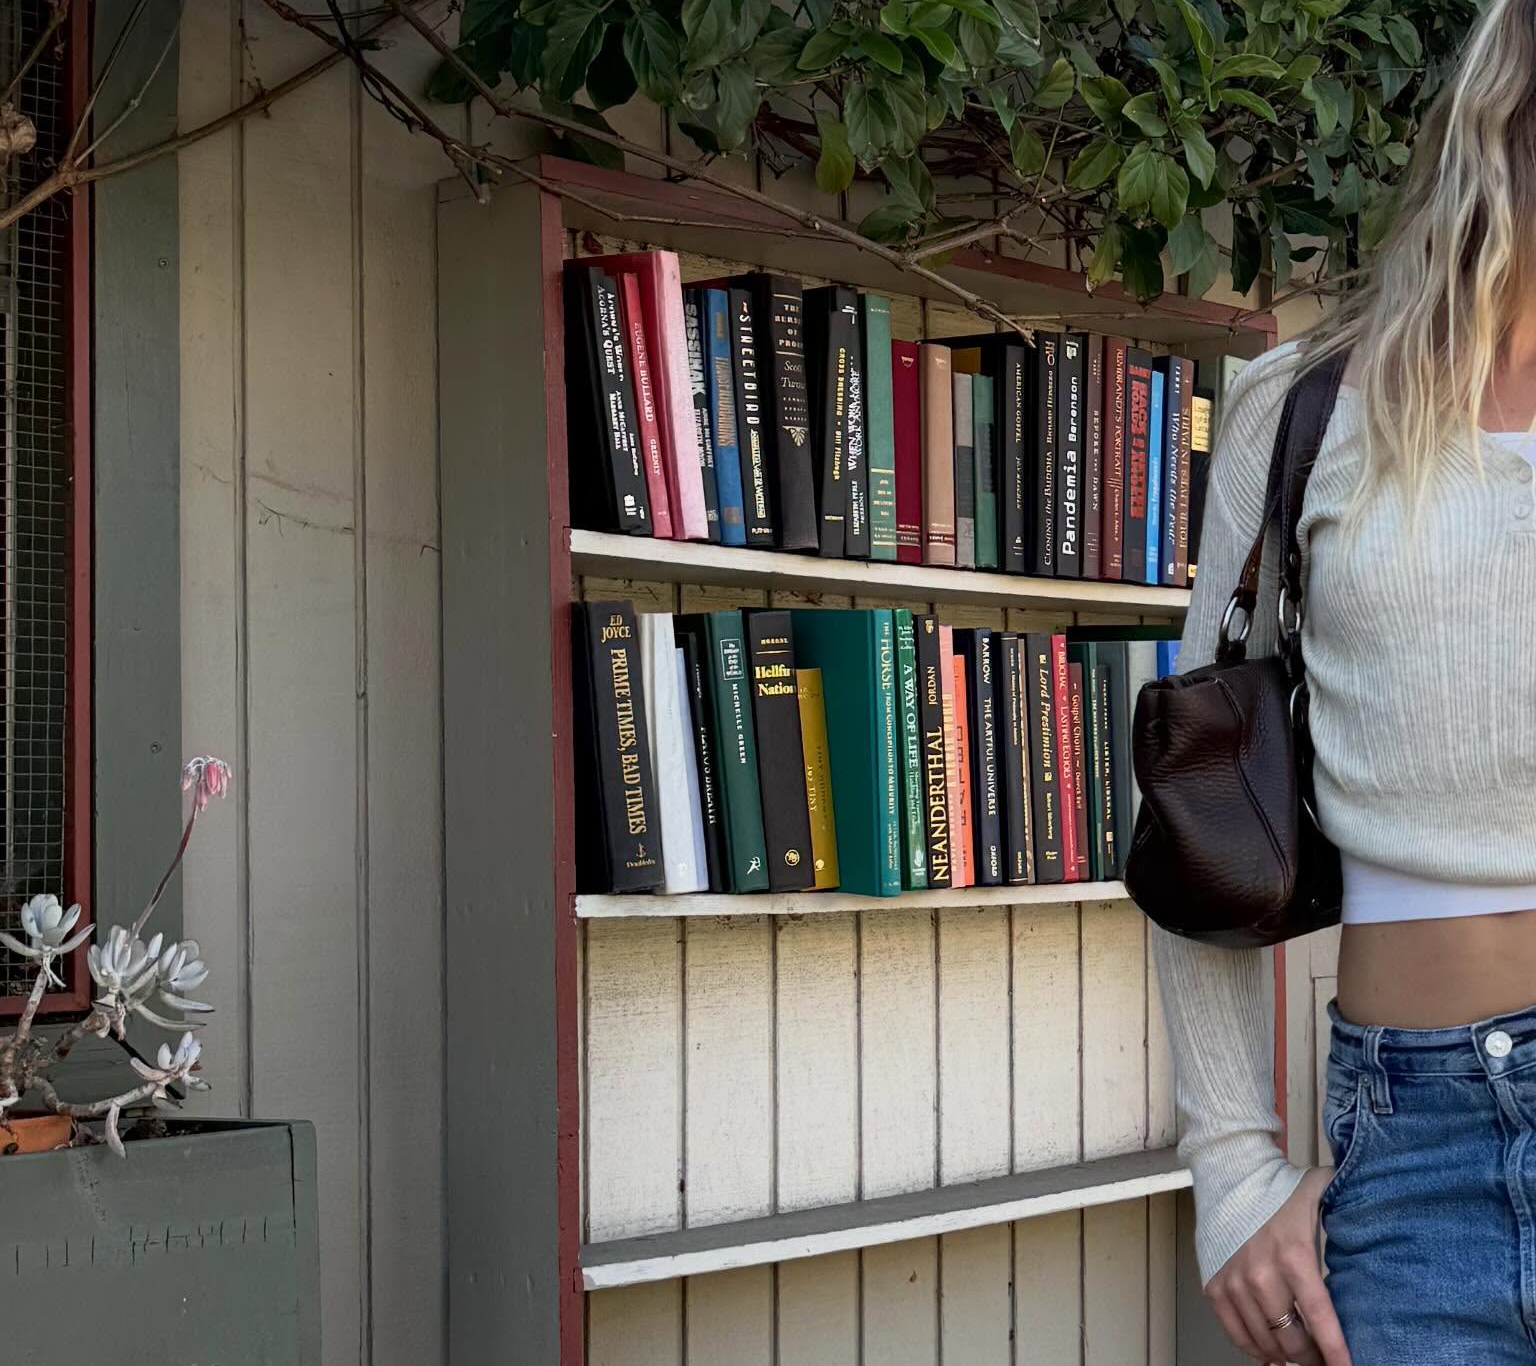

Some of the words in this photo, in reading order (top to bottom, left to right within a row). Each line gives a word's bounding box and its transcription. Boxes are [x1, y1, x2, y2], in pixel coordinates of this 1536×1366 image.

[602, 340, 616, 375] QUEST
[633, 322, 648, 368] EUGENE
[685, 302, 706, 396] SASSINAK
[739, 314, 761, 425] STREETBIRD
[1015, 362, 1023, 409] AMERICAN
[1114, 348, 1123, 424] REMBRANDT'S
[640, 369, 654, 422] BULLARD
[1068, 376, 1078, 442] Berenson
[1171, 412, 1180, 441] Who
[848, 436, 858, 471] WHEN
[1043, 451, 1053, 497] BUDDHA
[1114, 425, 1122, 477] PORTRAIT
[1170, 445, 1179, 485] Needs
[1062, 450, 1077, 555] Pandemia
[1044, 518, 1052, 566] CLONING
[601, 625, 632, 643] JOYCE
[609, 614, 623, 626] ED
[610, 648, 631, 698] PRIME
[903, 663, 913, 675] A
[982, 638, 991, 684] BARROW
[1039, 668, 1049, 699] Lord
[732, 683, 743, 730] MICHELLE
[880, 638, 893, 690] HORSE
[888, 765, 894, 775] TO
[903, 676, 915, 711] WAY
[926, 666, 938, 705] JORDAN
[983, 697, 992, 720] THE
[616, 699, 638, 752] TIMES,
[905, 712, 916, 733] OF
[984, 721, 994, 762] ARTFUL
[1041, 702, 1052, 768] Prestimion
[620, 754, 642, 785] BAD
[737, 734, 746, 764] GREEN
[907, 736, 918, 769] LIFE
[626, 786, 647, 834] TIMES
[927, 726, 948, 881] NEANDERTHAL
[986, 764, 996, 816] UNIVERSE
